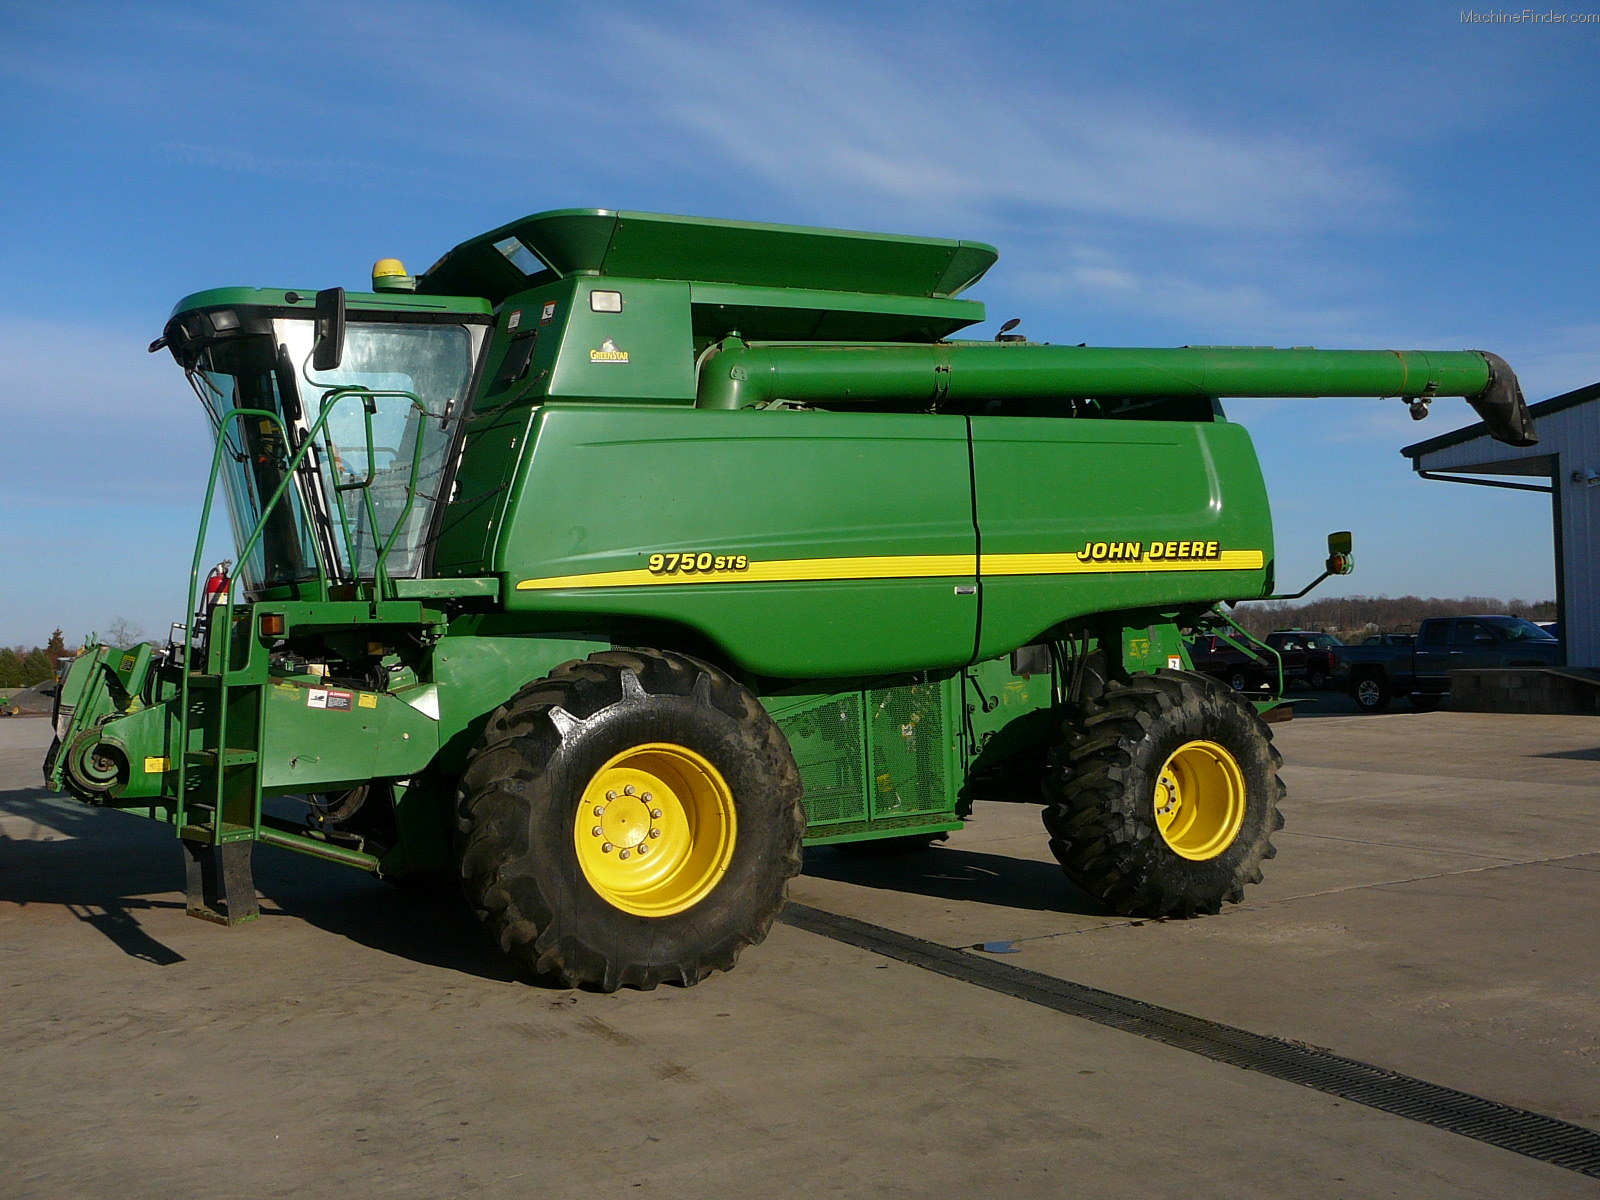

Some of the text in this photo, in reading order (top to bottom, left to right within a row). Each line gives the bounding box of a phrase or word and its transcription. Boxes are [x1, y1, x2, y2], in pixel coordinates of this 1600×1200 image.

[1076, 541, 1220, 561] JOHN DEERE
[648, 552, 748, 574] 9750 STS
